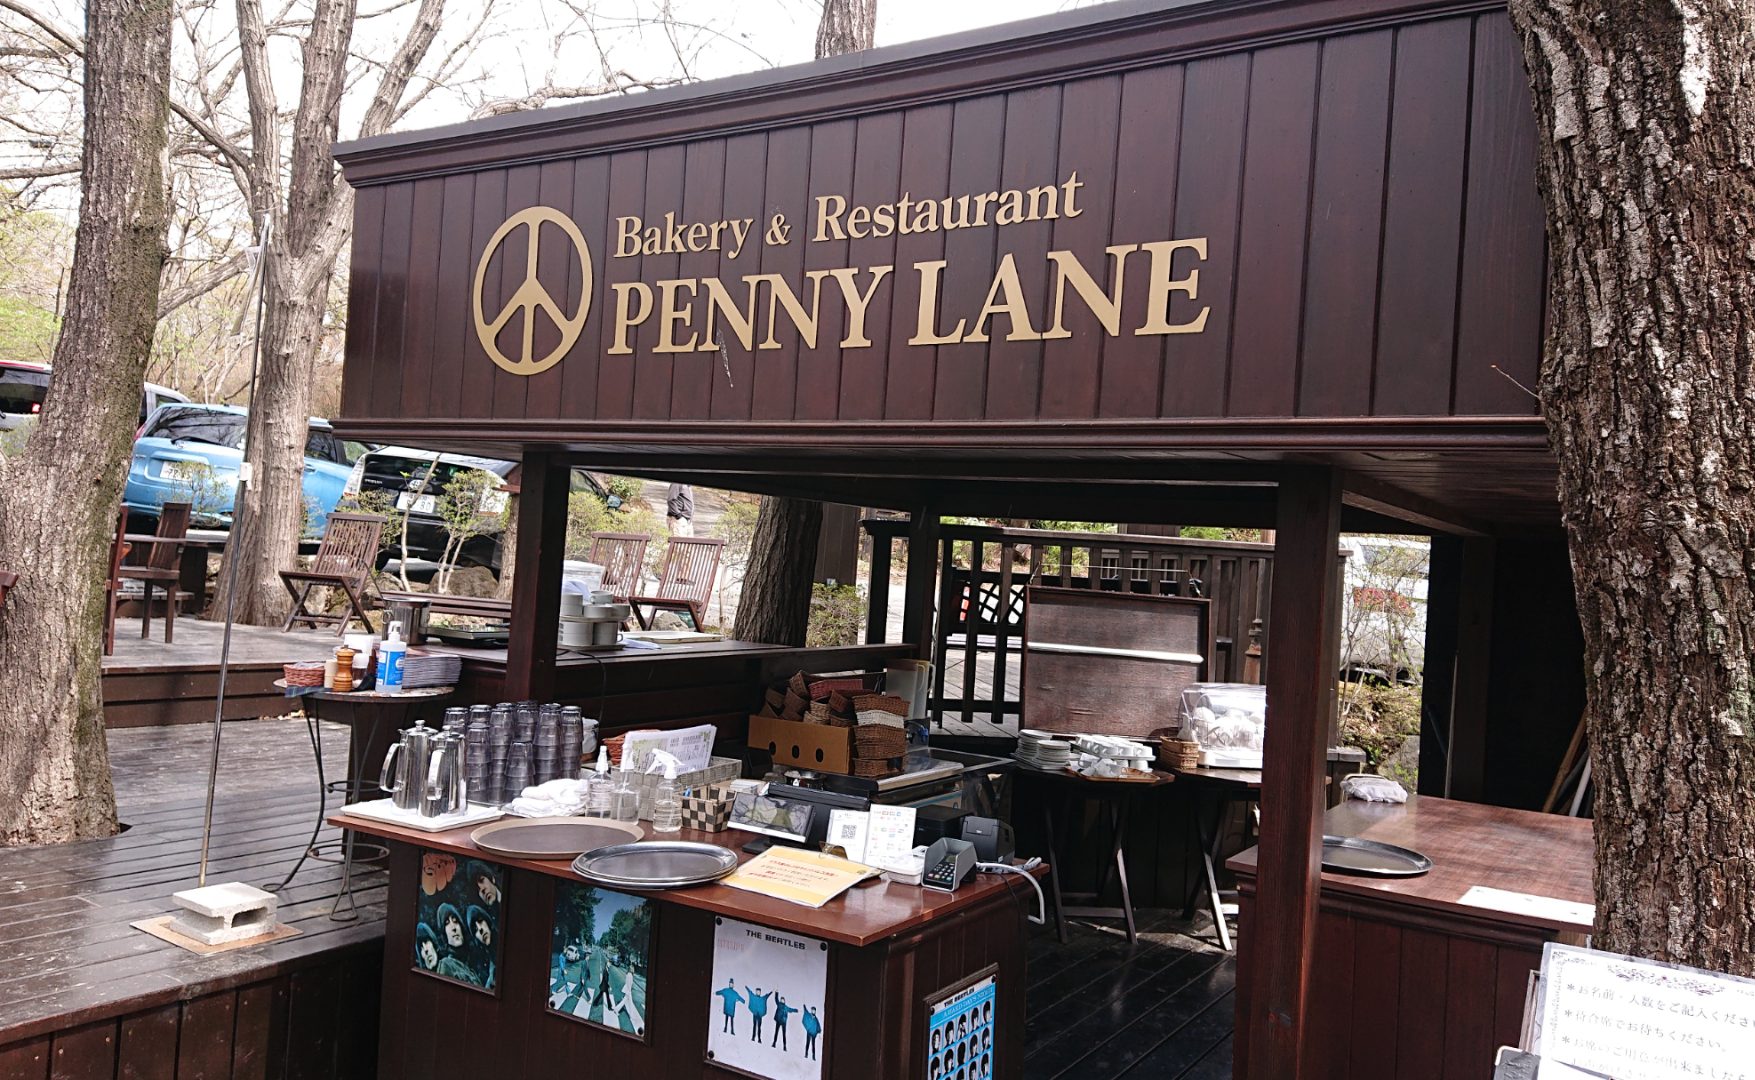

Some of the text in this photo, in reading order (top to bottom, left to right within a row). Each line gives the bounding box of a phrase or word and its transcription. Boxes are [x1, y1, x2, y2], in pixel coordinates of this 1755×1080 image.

[613, 170, 1084, 259] Bakery & Restaurant
[607, 237, 1211, 355] PENNY LANE
[745, 929, 806, 950] THE BEATLES
[1567, 984, 1755, 1028] お名前・人数をご記入くださ
